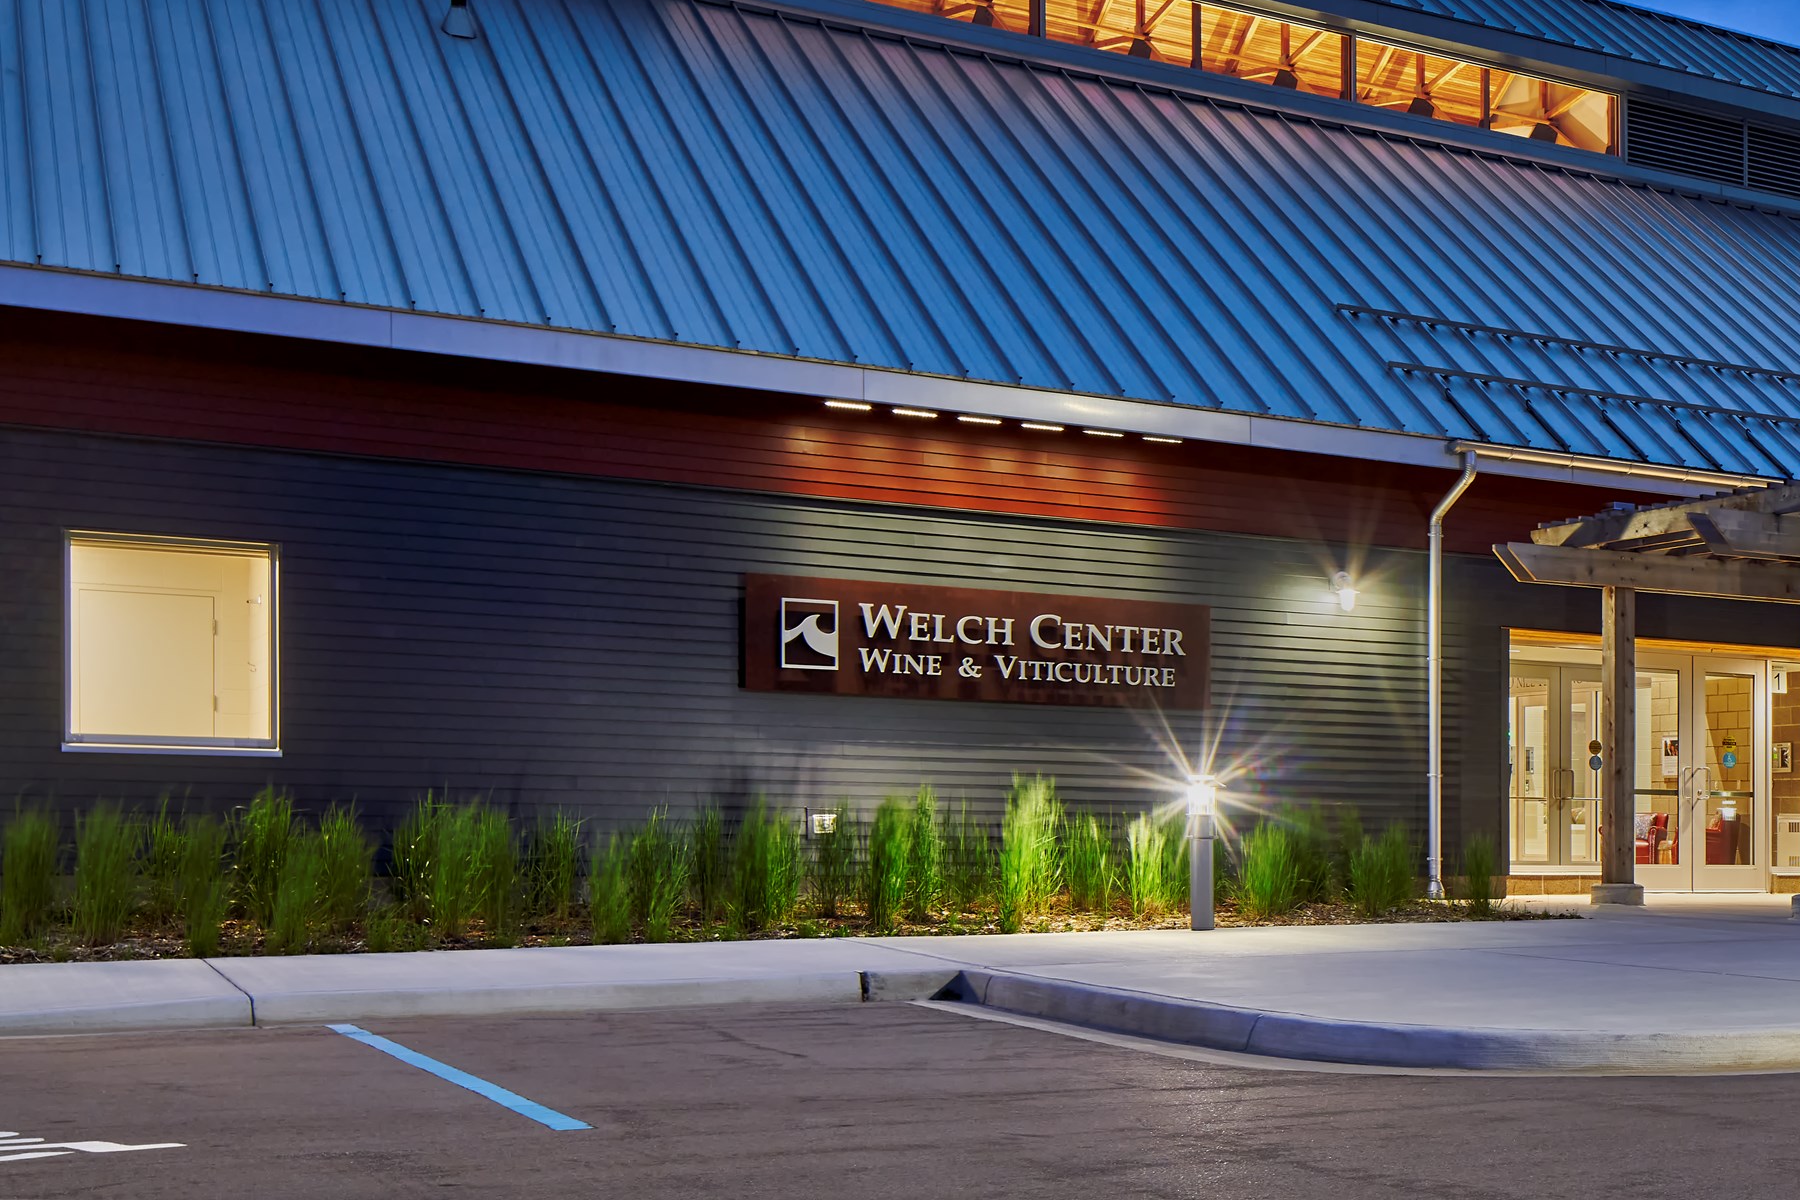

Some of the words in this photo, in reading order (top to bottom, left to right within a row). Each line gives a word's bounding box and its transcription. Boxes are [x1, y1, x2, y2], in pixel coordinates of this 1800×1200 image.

[858, 602, 1015, 646] WELCH
[1029, 613, 1187, 656] CENTER
[857, 647, 943, 676] WINE
[957, 656, 983, 678] &
[993, 654, 1176, 687] VITICULTURE
[1773, 672, 1781, 691] 1
